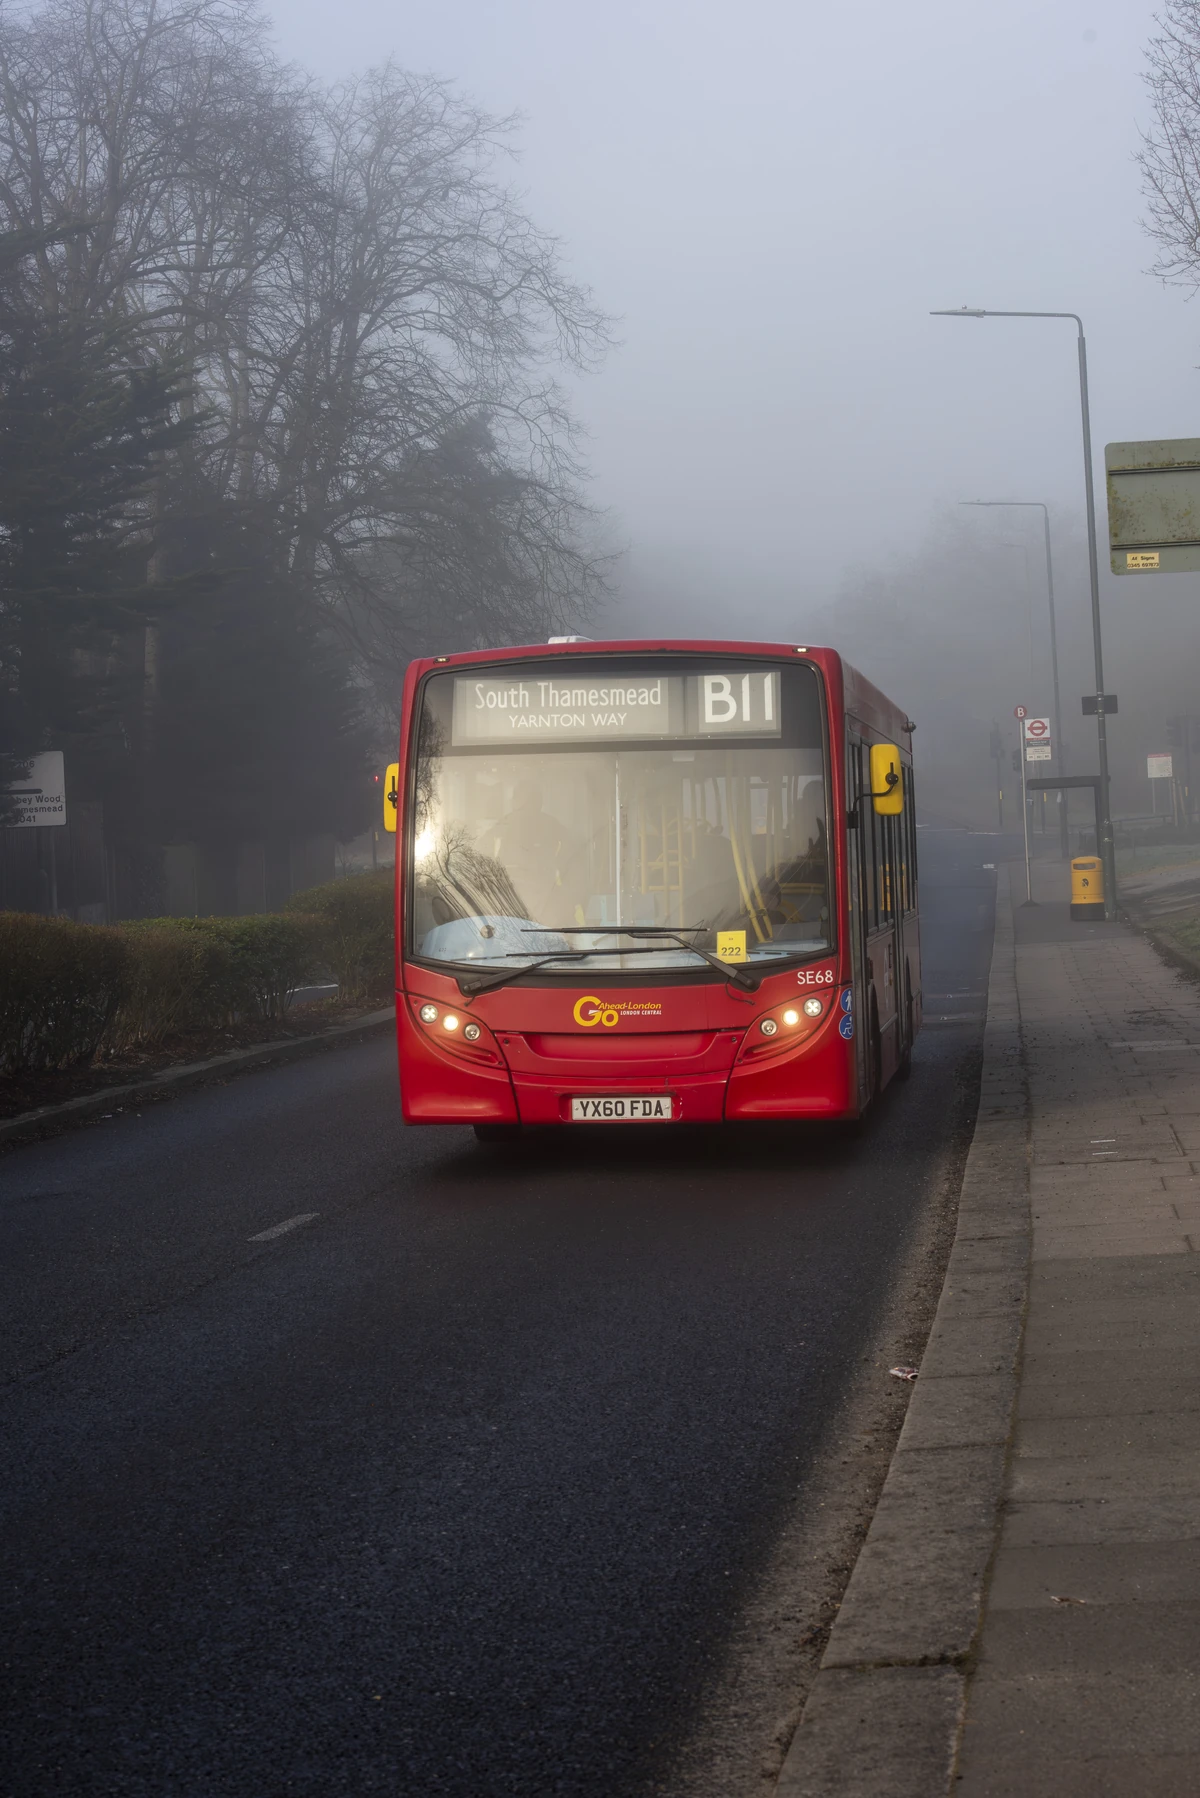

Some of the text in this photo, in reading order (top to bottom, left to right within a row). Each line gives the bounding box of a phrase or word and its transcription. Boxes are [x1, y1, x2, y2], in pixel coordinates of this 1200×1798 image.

[474, 680, 661, 709] South Thamesmead
[704, 673, 773, 723] B11
[1017, 707, 1025, 717] B
[508, 712, 628, 728] YARNTON WAY
[16, 795, 61, 805] bey Wood
[21, 804, 63, 814] mesmead
[721, 946, 741, 957] 222
[797, 970, 834, 985] SE68
[580, 1100, 664, 1117] YX60 FDA
